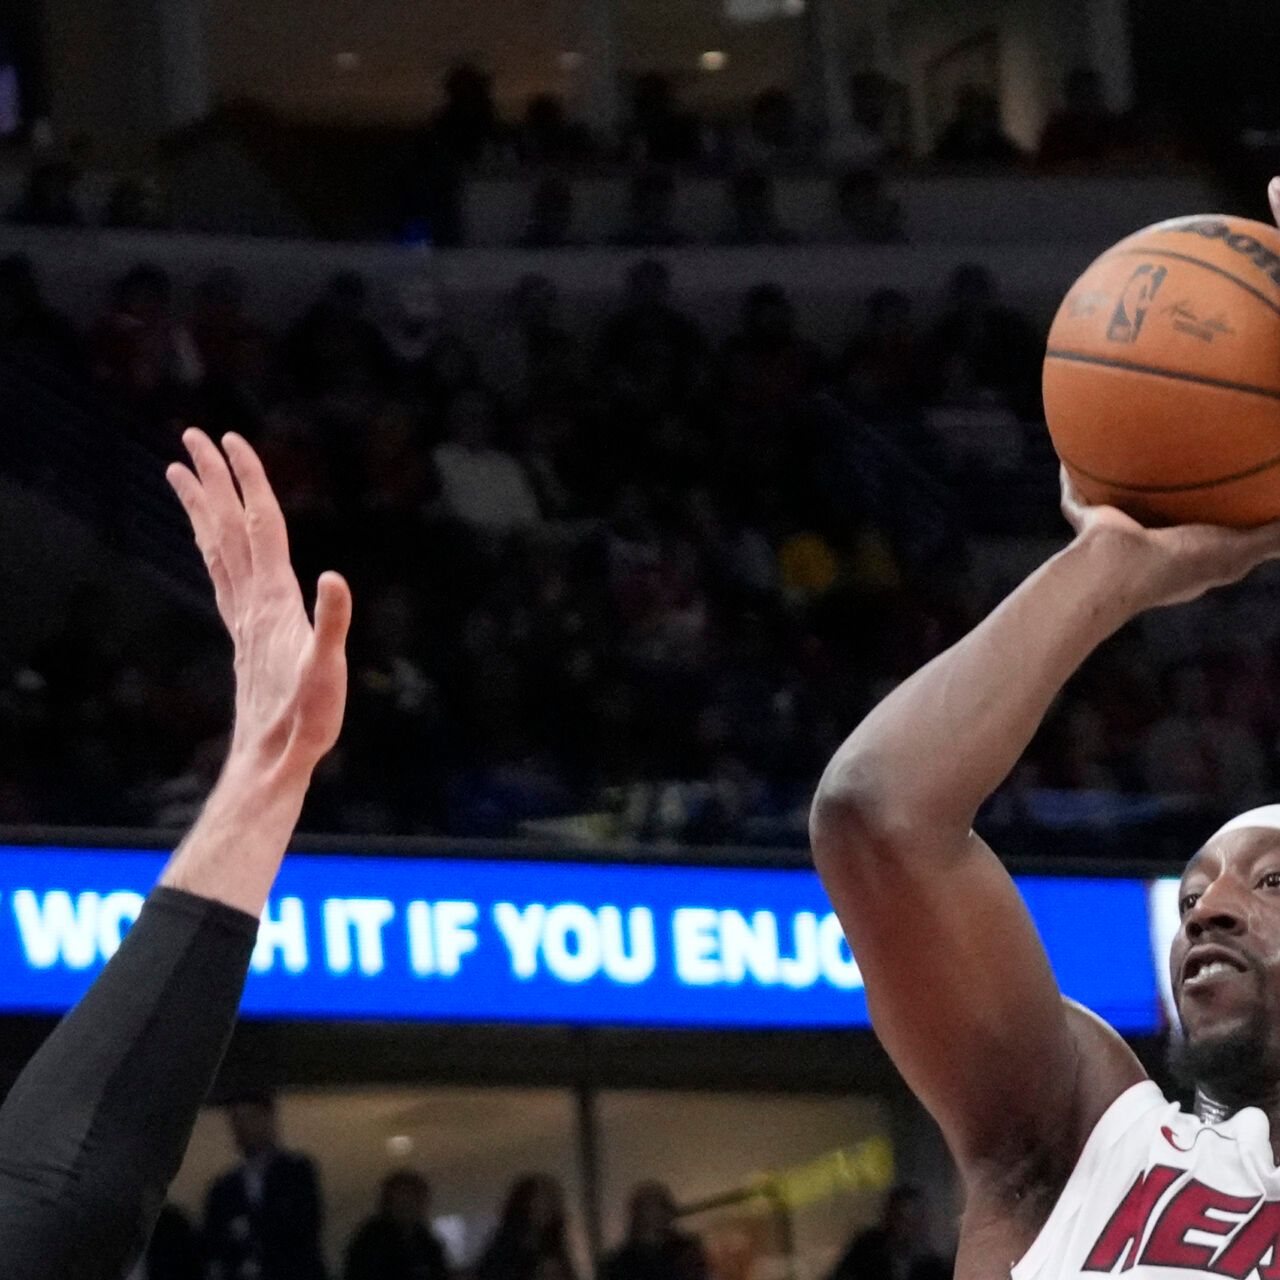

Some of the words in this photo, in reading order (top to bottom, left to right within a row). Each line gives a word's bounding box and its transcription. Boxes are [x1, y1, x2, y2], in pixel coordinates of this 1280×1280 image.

[13, 888, 309, 975] WOH
[323, 897, 395, 976] IT
[406, 898, 479, 979] IF
[494, 901, 656, 985] YOU
[672, 907, 866, 989] ENJO
